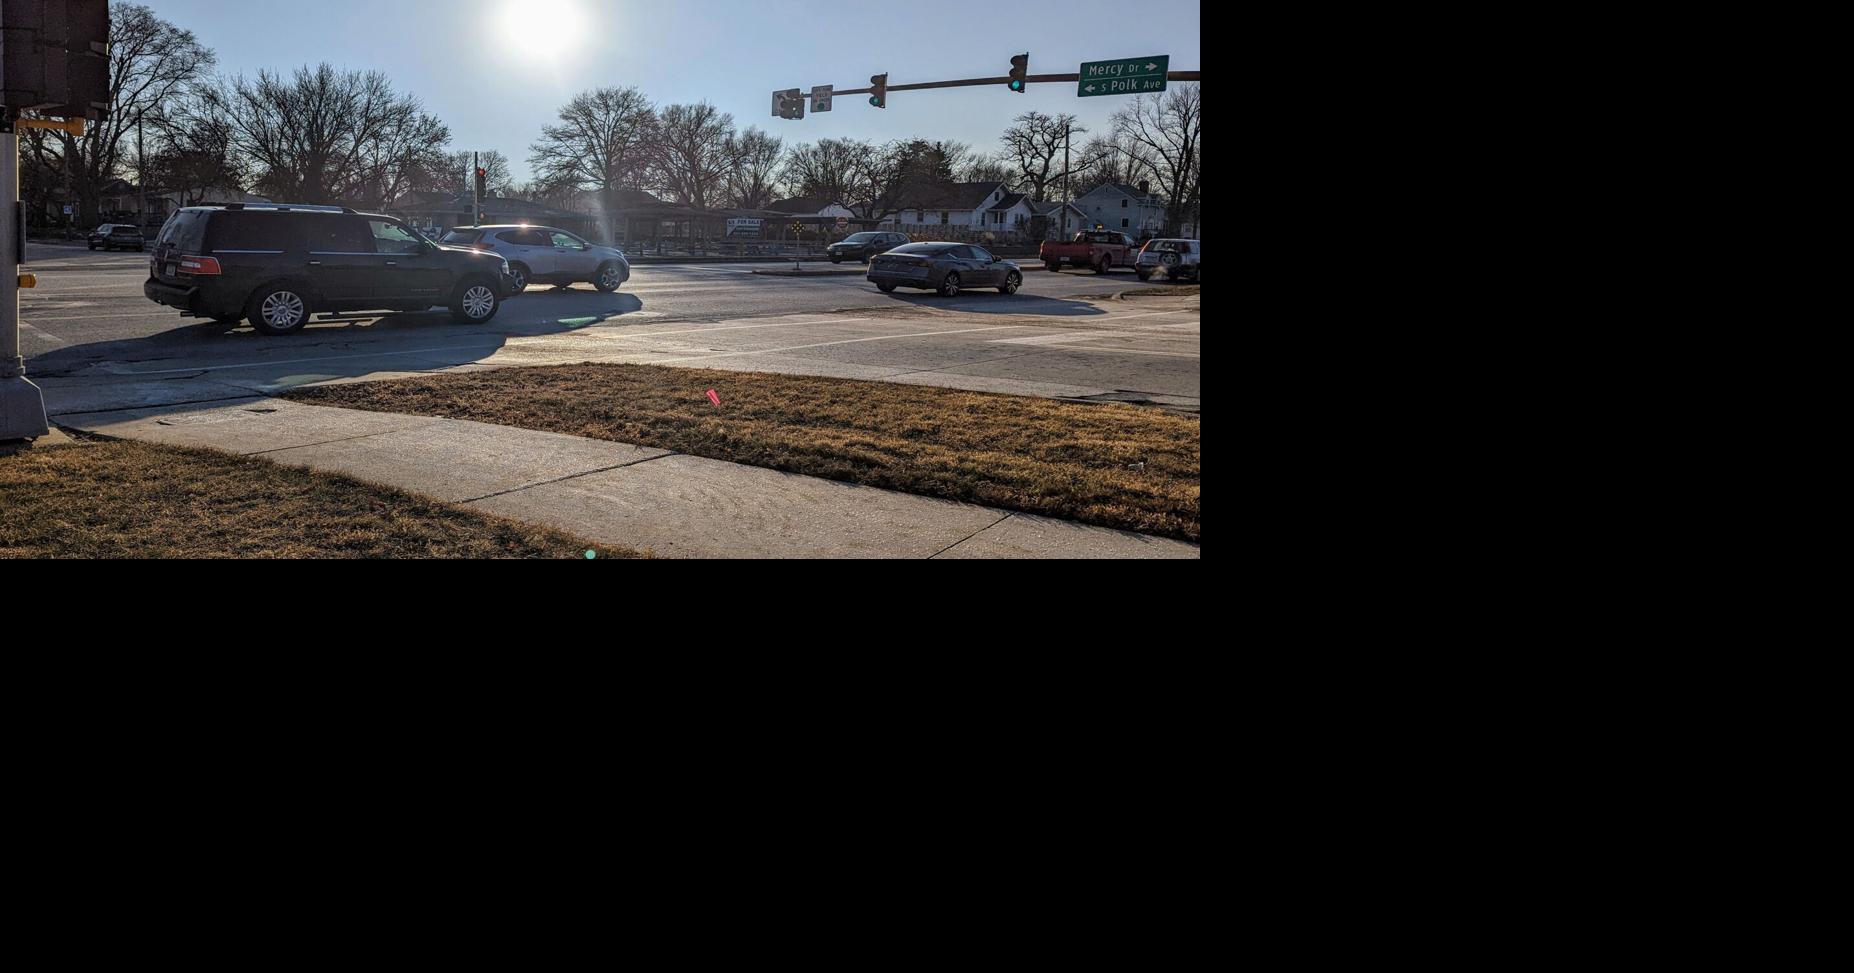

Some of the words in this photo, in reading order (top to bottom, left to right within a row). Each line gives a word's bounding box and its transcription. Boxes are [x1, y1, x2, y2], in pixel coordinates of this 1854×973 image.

[1089, 63, 1124, 76] Mercy
[1128, 64, 1140, 73] Dr
[1101, 83, 1107, 92] S
[1111, 78, 1138, 91] Polk
[1143, 80, 1161, 89] Ave
